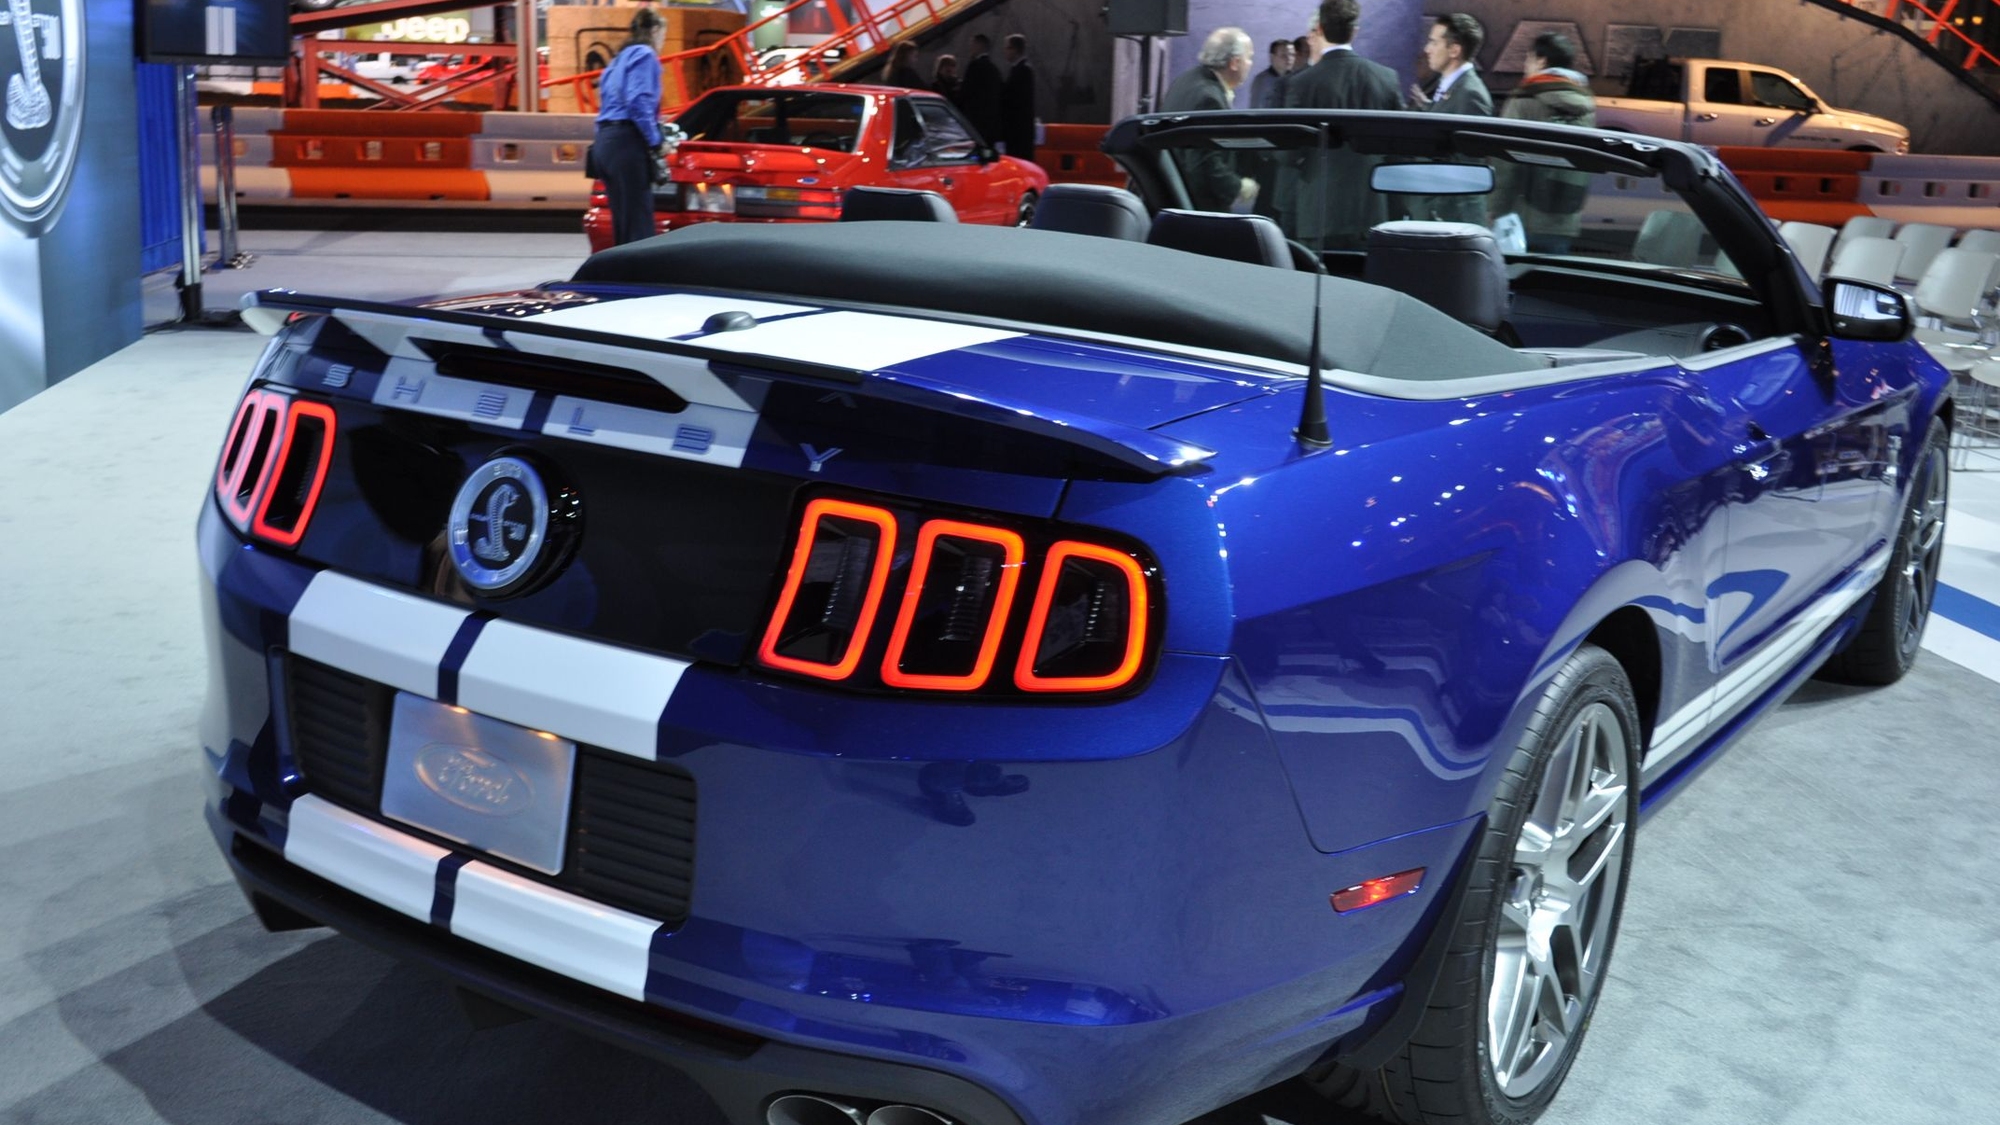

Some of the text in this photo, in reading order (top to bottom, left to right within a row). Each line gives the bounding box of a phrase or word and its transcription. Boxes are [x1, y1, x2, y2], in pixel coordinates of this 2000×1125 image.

[380, 16, 470, 44] Jeep
[322, 363, 843, 472] SHELBY
[437, 756, 514, 804] Ford
